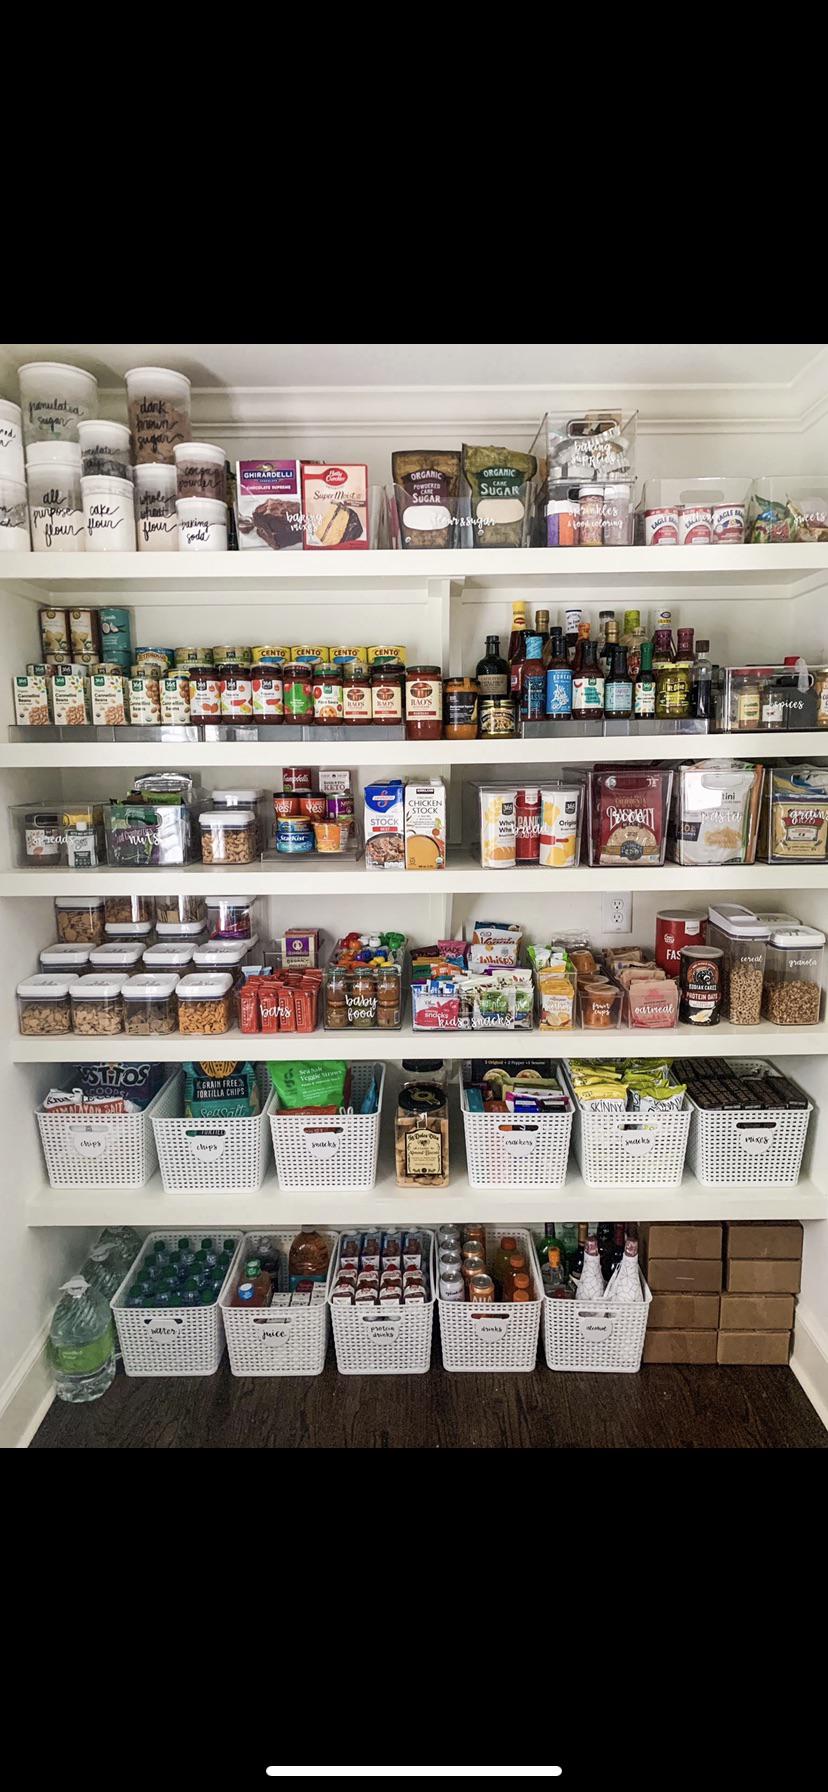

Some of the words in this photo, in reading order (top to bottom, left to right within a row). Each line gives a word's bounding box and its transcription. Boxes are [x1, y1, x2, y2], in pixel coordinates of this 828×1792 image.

[140, 397, 168, 415] dark
[37, 416, 75, 430] sugar
[138, 432, 184, 451] sugar
[574, 440, 612, 454] baking
[243, 471, 293, 479] GHIRARDELLI
[411, 470, 443, 480] ORGANIC
[483, 469, 516, 478] ORGANIC
[480, 483, 520, 496] SUGAR
[43, 489, 68, 504] all
[412, 493, 441, 504] SUGAR
[89, 504, 121, 517] cake
[33, 507, 83, 528] purpose
[286, 511, 323, 526] baking
[87, 518, 124, 535] flour
[142, 520, 178, 542] flour
[45, 521, 85, 547] flour
[186, 530, 211, 544] soda
[773, 700, 805, 710] spices
[370, 818, 399, 826] STOCK
[128, 832, 160, 845] nuts
[788, 958, 817, 967] granola
[688, 983, 704, 991] KODIAK
[345, 994, 379, 1010] baby
[260, 1004, 292, 1017] bars
[347, 1007, 376, 1022] food
[634, 1004, 674, 1015] oatmeal
[438, 1015, 463, 1027] kids
[471, 1014, 513, 1028] snacks
[202, 1079, 221, 1089] GRAIN
[222, 1079, 238, 1088] FREE
[196, 1089, 225, 1099] TORTILLA
[226, 1088, 245, 1097] CHIPS
[590, 1101, 622, 1112] SKINNY
[80, 1139, 102, 1148] chips
[311, 1140, 337, 1149] snacks
[505, 1139, 533, 1147] crackers
[624, 1137, 650, 1146] snacks
[744, 1136, 768, 1145] mixes
[196, 1143, 218, 1152] chips
[262, 1329, 286, 1340] juice
[370, 1325, 395, 1333] protein
